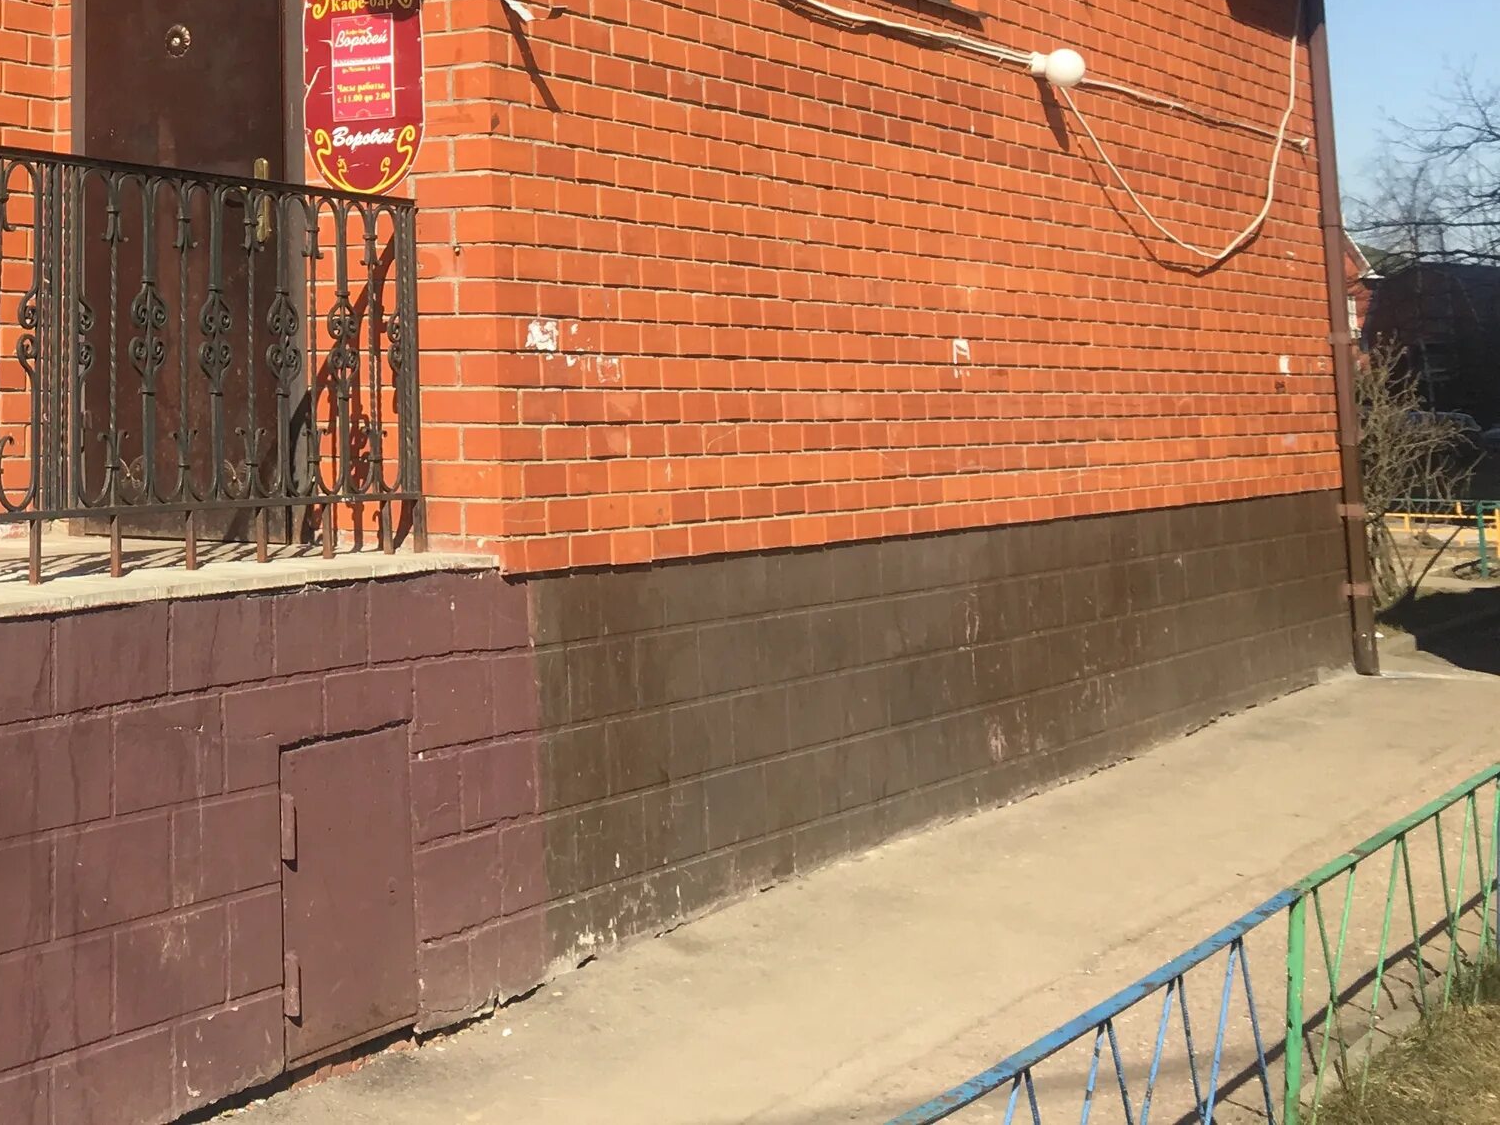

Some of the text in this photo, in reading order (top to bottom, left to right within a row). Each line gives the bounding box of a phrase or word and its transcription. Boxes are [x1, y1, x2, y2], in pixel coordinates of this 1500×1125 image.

[334, 27, 388, 52] Воробей
[337, 84, 356, 92] Часы
[332, 126, 396, 150] Воробей
